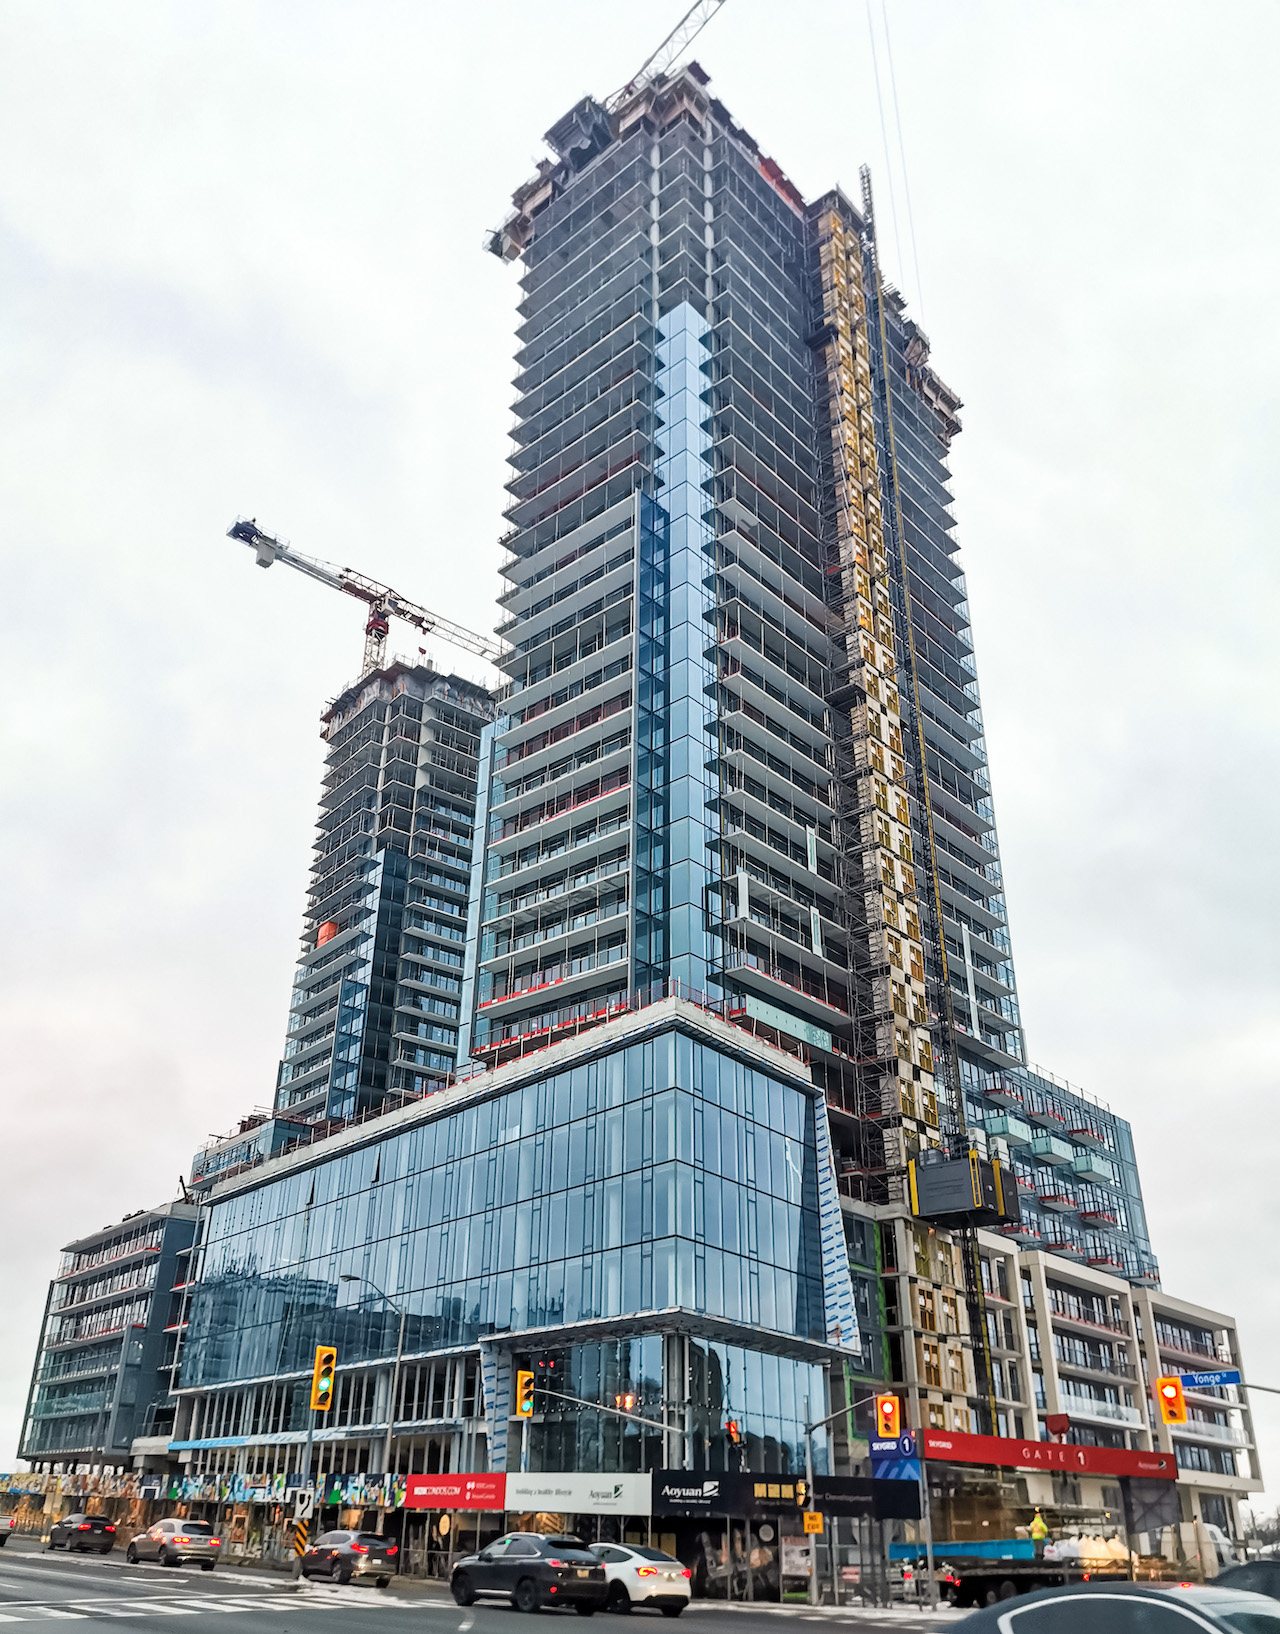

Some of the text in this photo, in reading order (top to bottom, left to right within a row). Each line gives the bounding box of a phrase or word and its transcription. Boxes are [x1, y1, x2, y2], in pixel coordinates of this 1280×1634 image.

[1193, 1374, 1220, 1386] Yonge
[872, 1438, 909, 1452] SKYGRID 1
[1022, 1447, 1085, 1465] GATE 1
[588, 1490, 613, 1500] Aoyuan
[661, 1485, 702, 1499] Aoyuan
